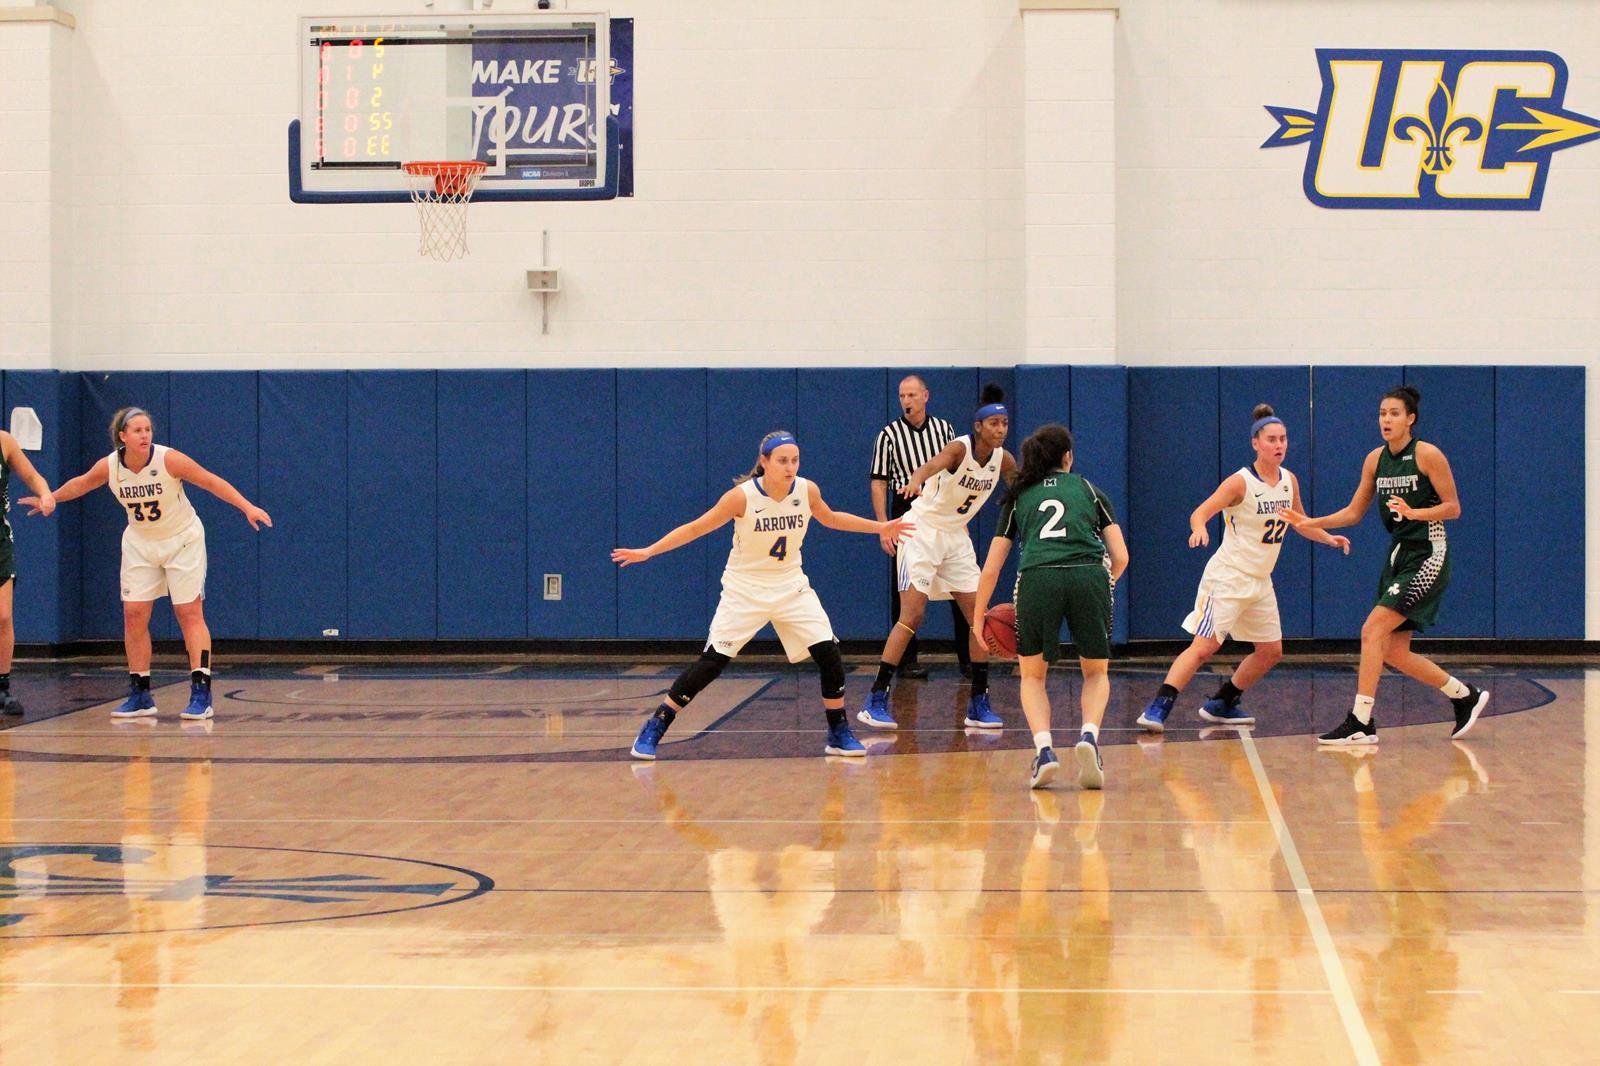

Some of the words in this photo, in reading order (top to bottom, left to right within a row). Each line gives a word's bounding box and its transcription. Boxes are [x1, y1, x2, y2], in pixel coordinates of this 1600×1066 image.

[472, 59, 562, 84] MAKE
[1312, 57, 1558, 202] UC
[119, 483, 163, 498] ARROWS
[127, 500, 162, 522] 33
[957, 495, 978, 514] 5
[754, 514, 804, 532] ARROWS
[1038, 499, 1067, 540] 2
[1261, 519, 1286, 545] 22
[769, 536, 788, 561] 4
